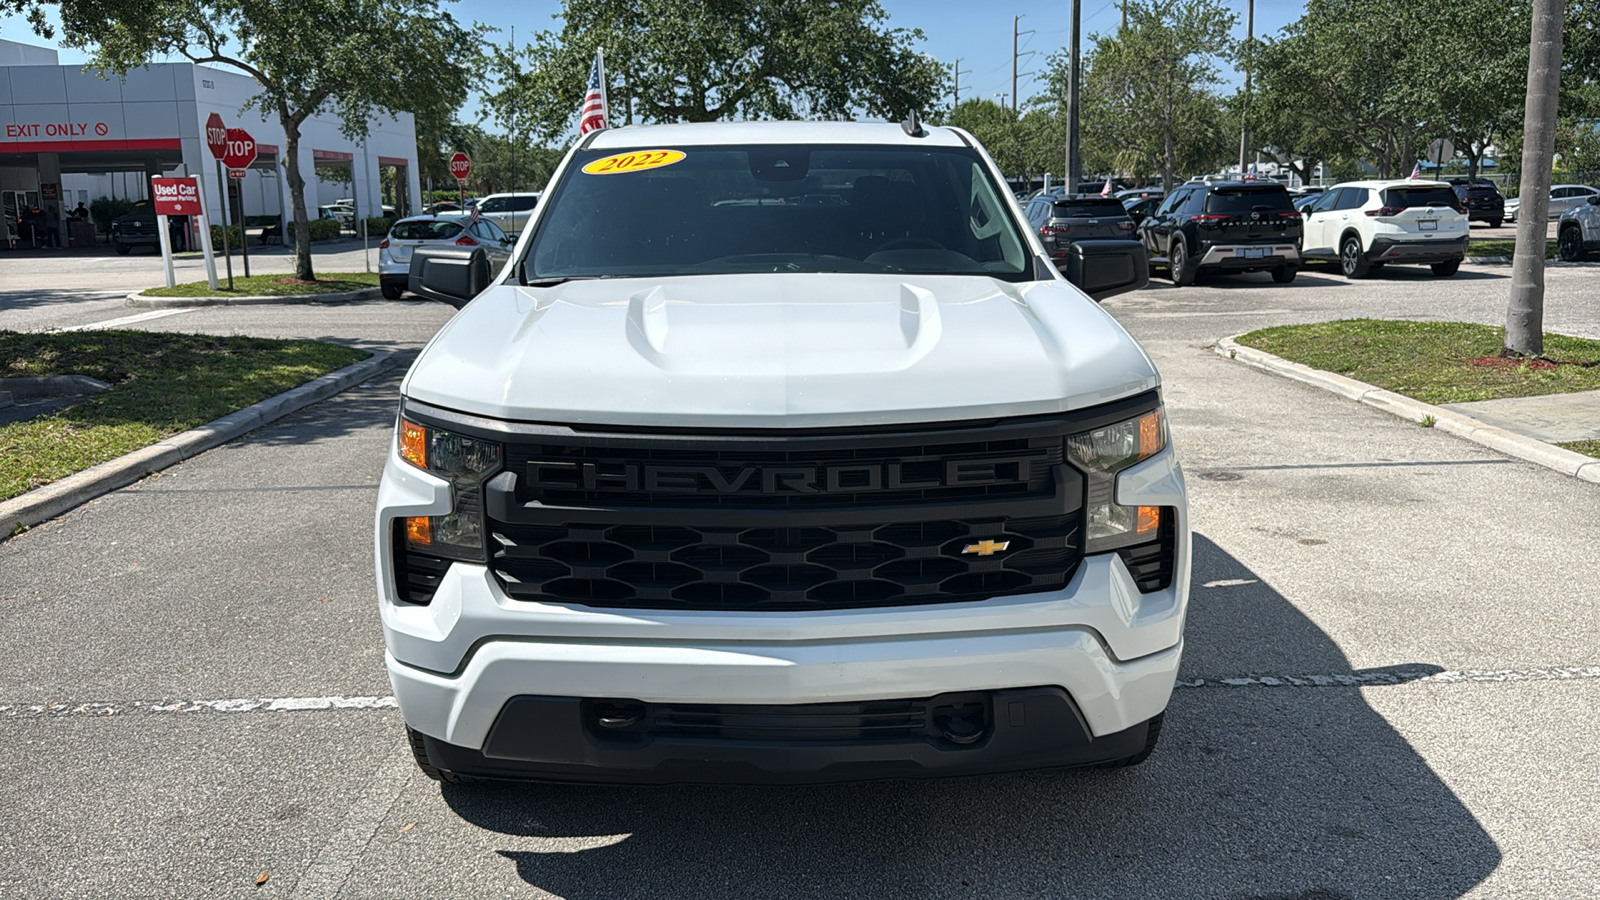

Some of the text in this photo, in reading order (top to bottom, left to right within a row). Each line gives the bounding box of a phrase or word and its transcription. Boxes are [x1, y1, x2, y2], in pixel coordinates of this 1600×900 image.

[6, 122, 88, 137] EXIT ONLY
[207, 127, 226, 145] STOP
[227, 140, 254, 157] TOP
[452, 160, 469, 172] STOP
[598, 152, 668, 172] 2022
[154, 183, 196, 195] Used Car
[178, 194, 198, 203] Parking
[526, 454, 1048, 494] CHEVROLET
